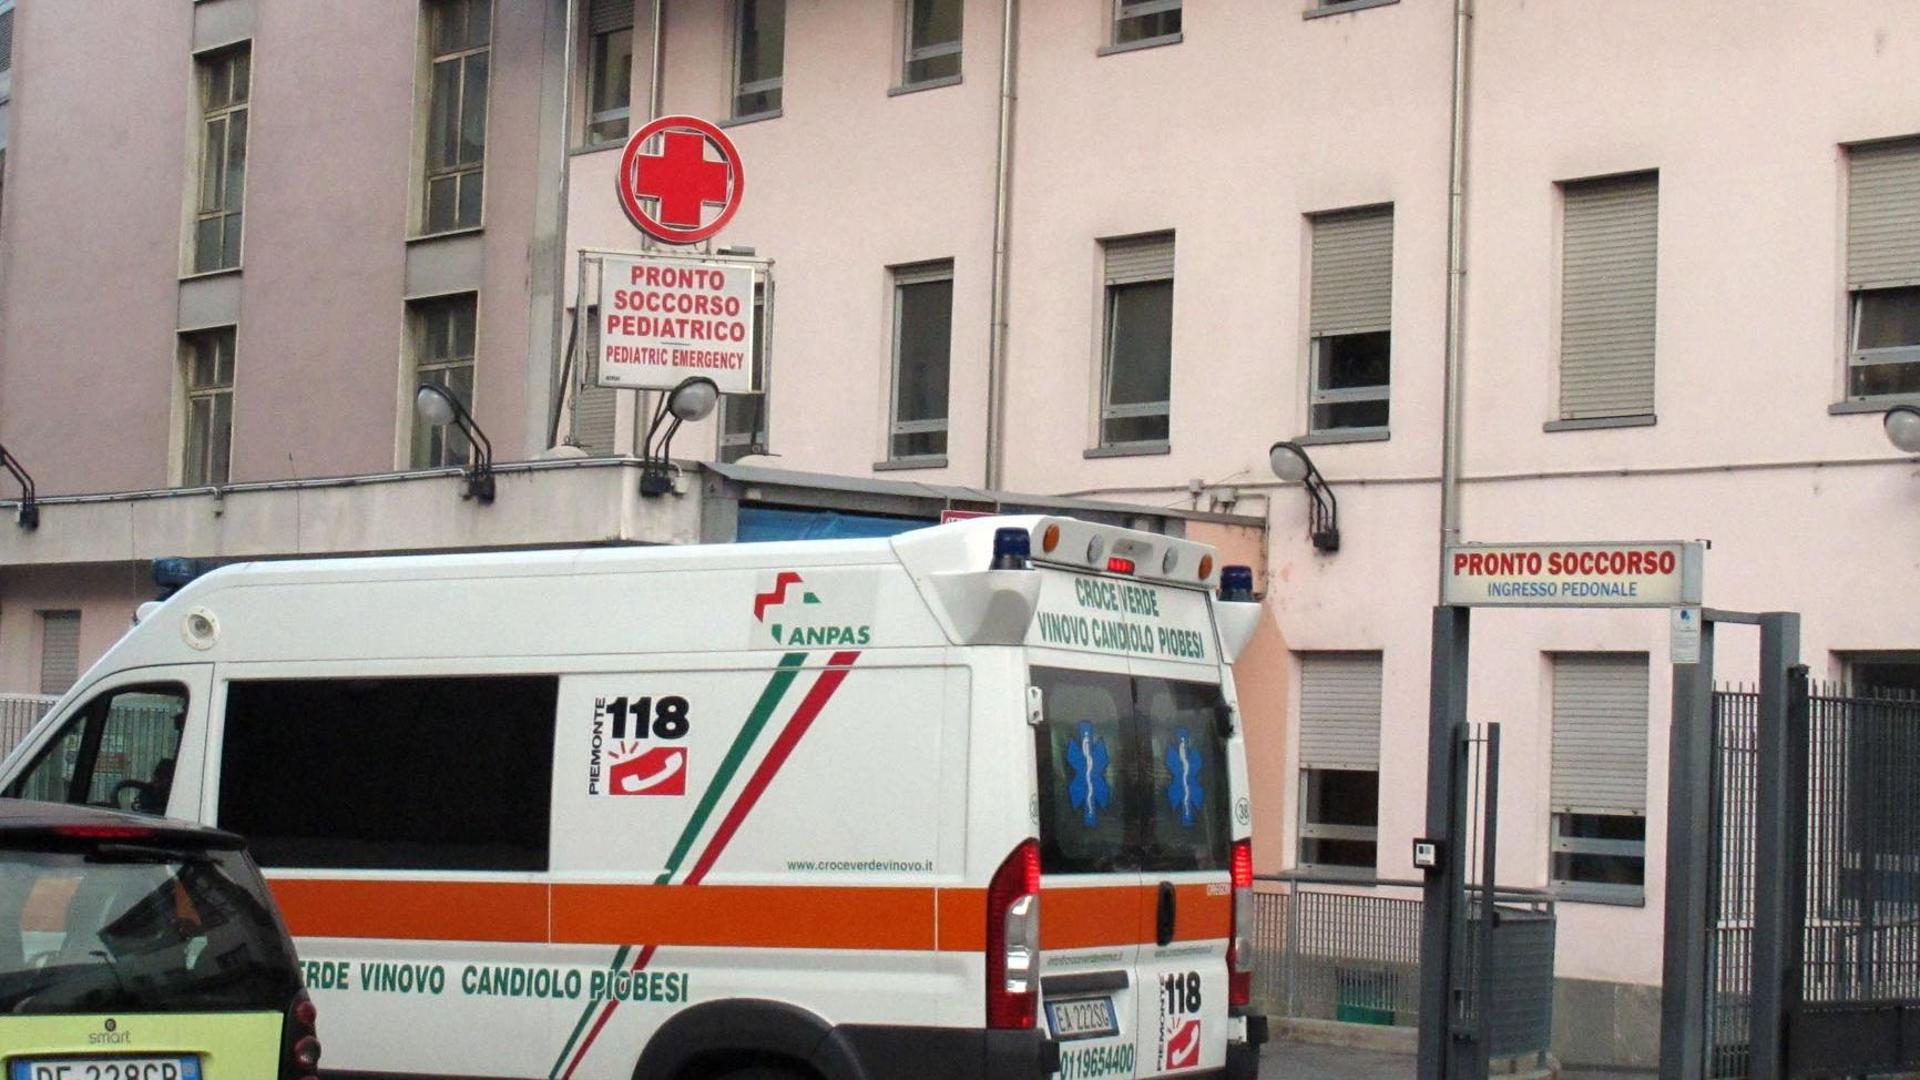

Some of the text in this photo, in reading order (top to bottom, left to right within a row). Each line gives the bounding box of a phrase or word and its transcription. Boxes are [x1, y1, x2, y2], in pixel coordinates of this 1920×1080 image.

[631, 266, 725, 290] PRONTO
[614, 289, 740, 316] SOCCORSO
[607, 315, 745, 342] PEDIATRICO
[606, 346, 744, 370] PEDIATRIC EMERGENCY
[1454, 551, 1676, 576] PRONTO SOCCORSO
[1075, 578, 1159, 617] CROCE VERDE
[1488, 582, 1637, 597] INGRESSO PEDONALE
[788, 625, 871, 646] ANPAS
[1037, 611, 1204, 659] VINOVO CANDIOLO PIOBESI
[606, 695, 690, 740] 118
[588, 696, 606, 796] PIEMONTE
[787, 859, 933, 871] www.croceverdevinovo.it
[360, 962, 446, 995] VINOVO
[461, 965, 583, 999] CANDIOLO
[590, 970, 689, 1003] PIOBESI
[1165, 971, 1202, 1014] 118
[88, 1031, 131, 1044] smart
